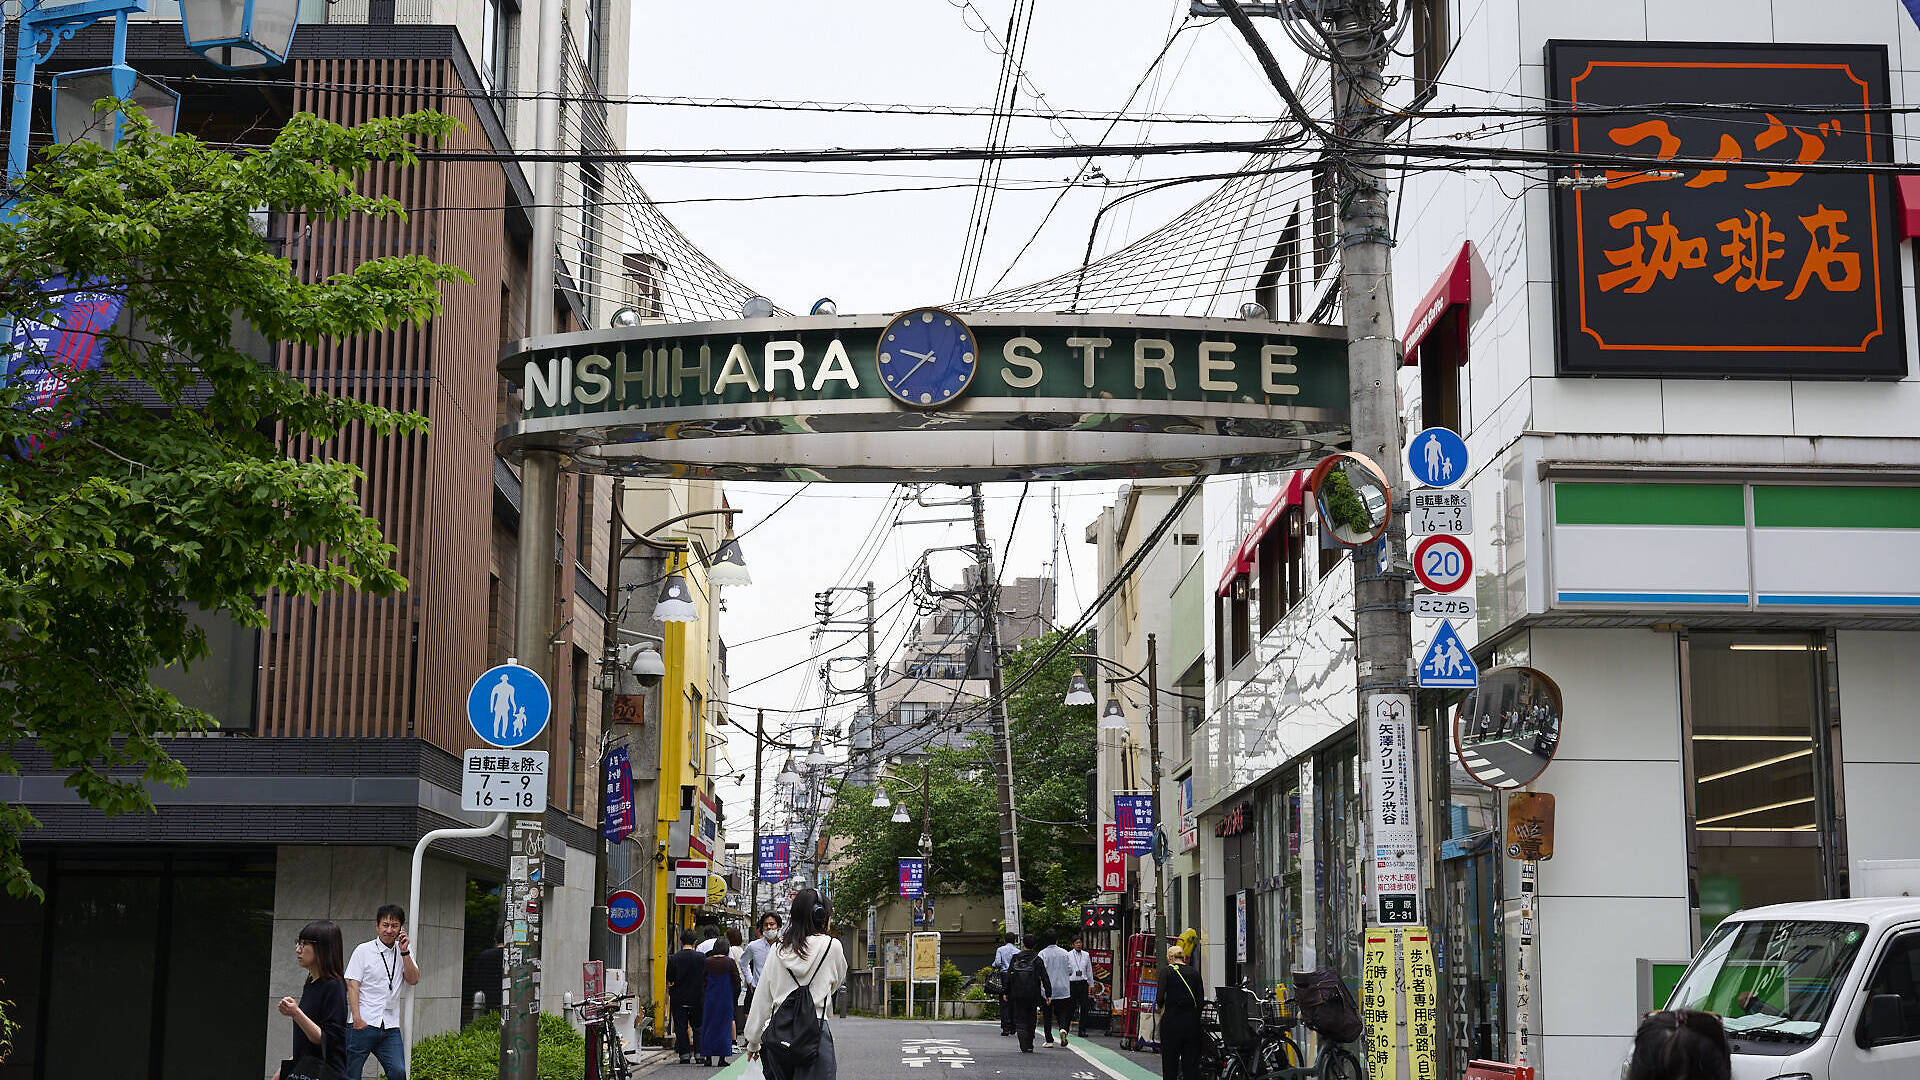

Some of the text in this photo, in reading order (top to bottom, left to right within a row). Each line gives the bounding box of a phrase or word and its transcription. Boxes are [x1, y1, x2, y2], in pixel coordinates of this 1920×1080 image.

[1598, 203, 1861, 300] 珈琲店
[523, 339, 860, 411] NISHIHARA
[1415, 494, 1467, 506] 自転車を除く
[1421, 520, 1463, 532] 16-18
[1427, 551, 1460, 577] 20
[1419, 600, 1470, 614] ここから
[469, 756, 544, 772] 自転車を除く
[1378, 723, 1397, 825] 矢澤クリニック渋谷
[475, 791, 533, 807] 16-18
[1377, 873, 1416, 882] 代々木上原駅
[610, 907, 638, 919] 消防水利
[1389, 911, 1412, 920] 2-31
